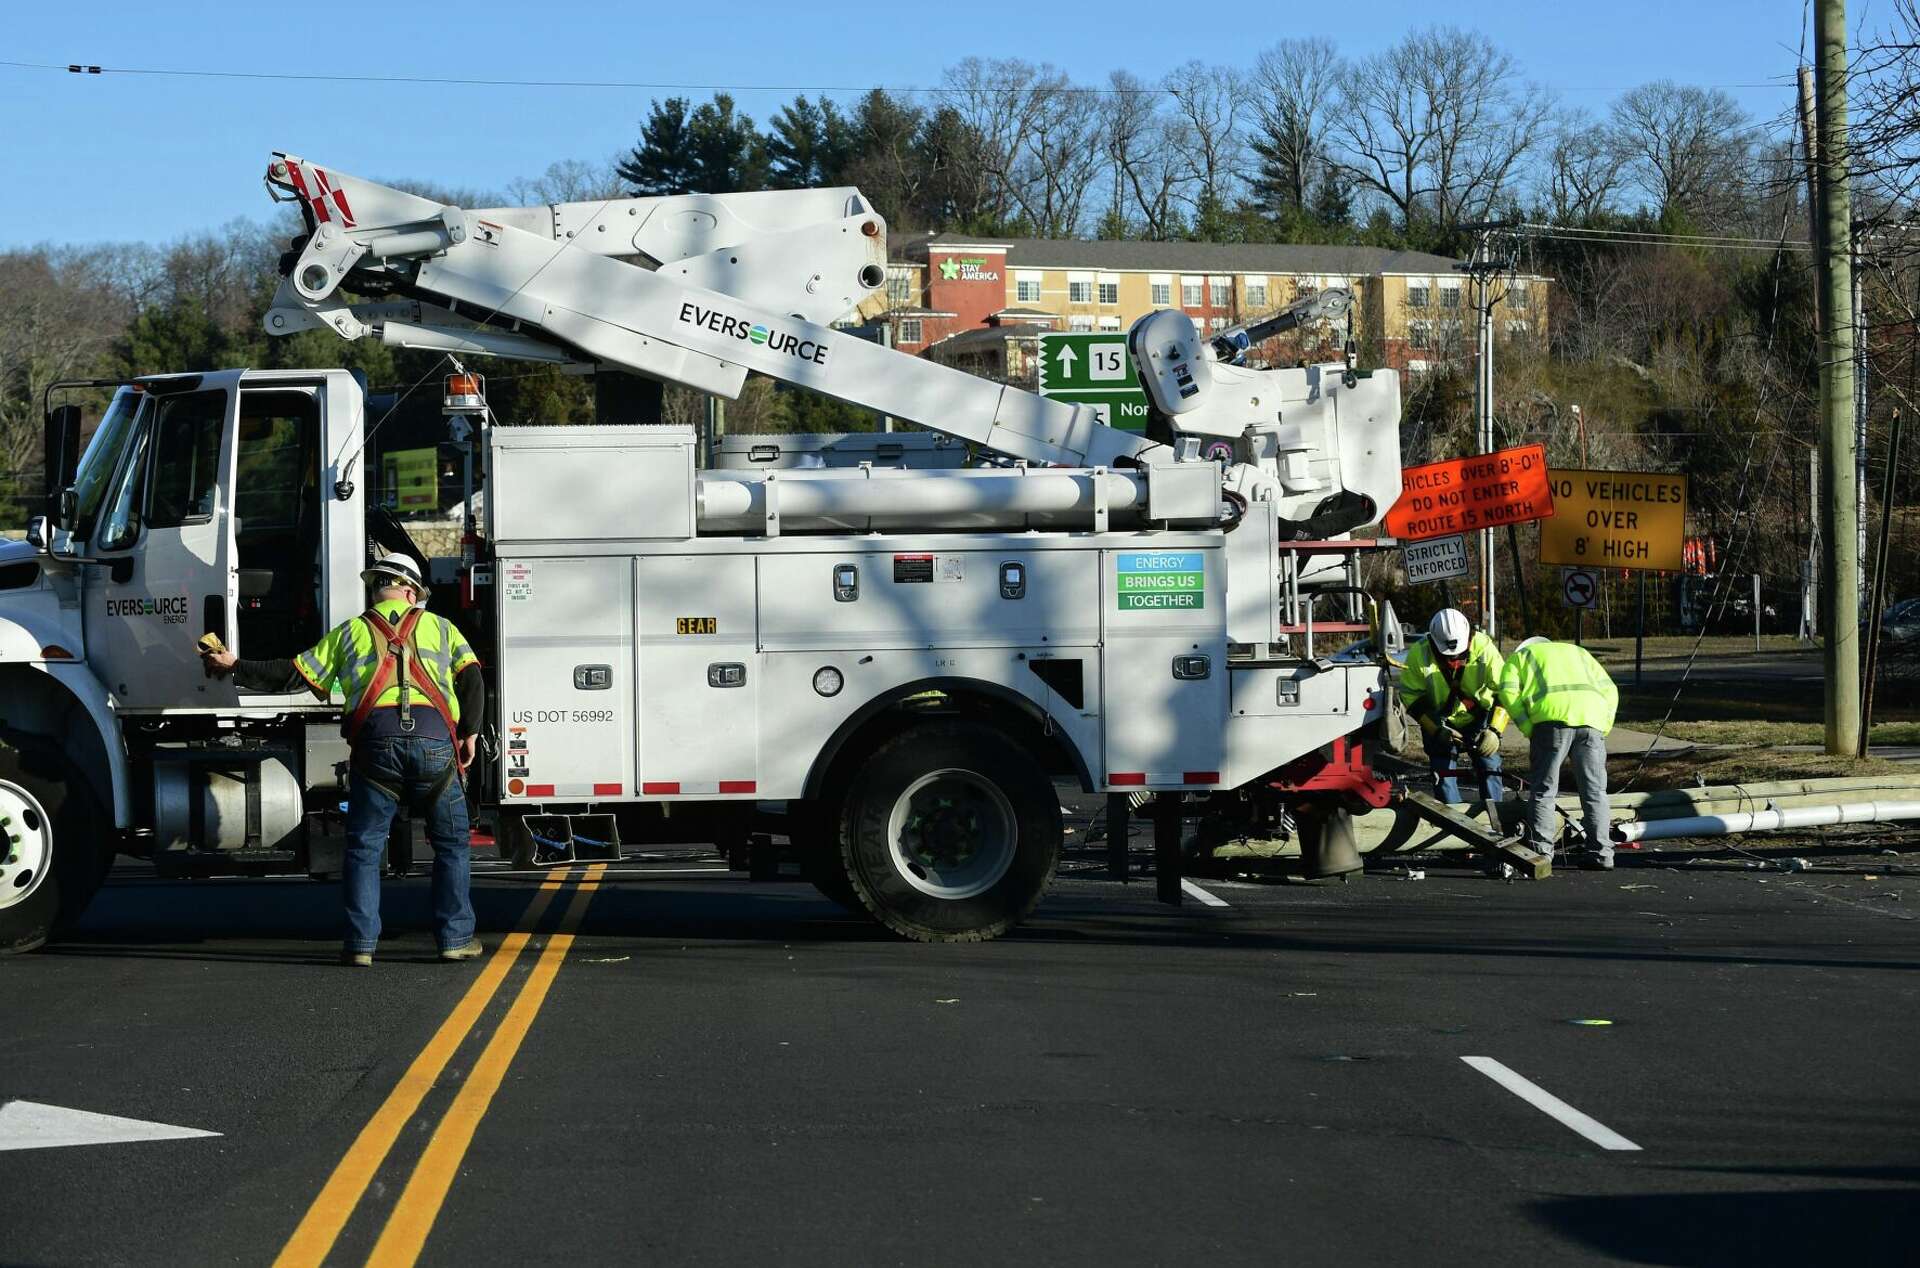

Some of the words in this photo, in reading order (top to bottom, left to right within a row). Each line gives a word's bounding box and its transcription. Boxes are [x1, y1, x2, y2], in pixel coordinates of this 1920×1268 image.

[961, 264, 980, 272] STAY
[961, 272, 999, 280] AMERICA
[679, 302, 828, 365] EVERSOURCE
[1094, 351, 1120, 371] 15
[1402, 470, 1450, 492] HICLES
[1460, 462, 1496, 481] OVER
[1411, 496, 1433, 513] DO
[1439, 490, 1466, 507] NOT
[1472, 480, 1520, 502] ENTER
[1549, 480, 1572, 498] NO
[1586, 480, 1682, 504] VEHICLES
[1407, 514, 1456, 536] ROUTE
[1461, 509, 1478, 526] 15
[1484, 501, 1534, 521] NORTH
[1586, 510, 1638, 530] OVER
[1407, 540, 1461, 562] STRICTLY
[1574, 537, 1590, 556] 8'
[1603, 539, 1649, 560] HIGH
[1135, 557, 1184, 569] ENERGY
[1409, 556, 1466, 577] ENFORCED
[1125, 575, 1175, 588] BRINGS
[1178, 575, 1196, 587] US
[106, 597, 188, 617] EVERSOURCE
[1127, 594, 1194, 607] TOGETHER
[163, 615, 188, 624] ENERGY
[677, 618, 716, 634] GEAR
[512, 710, 533, 723] US
[537, 710, 568, 722] DOT
[572, 710, 613, 722] 56992
